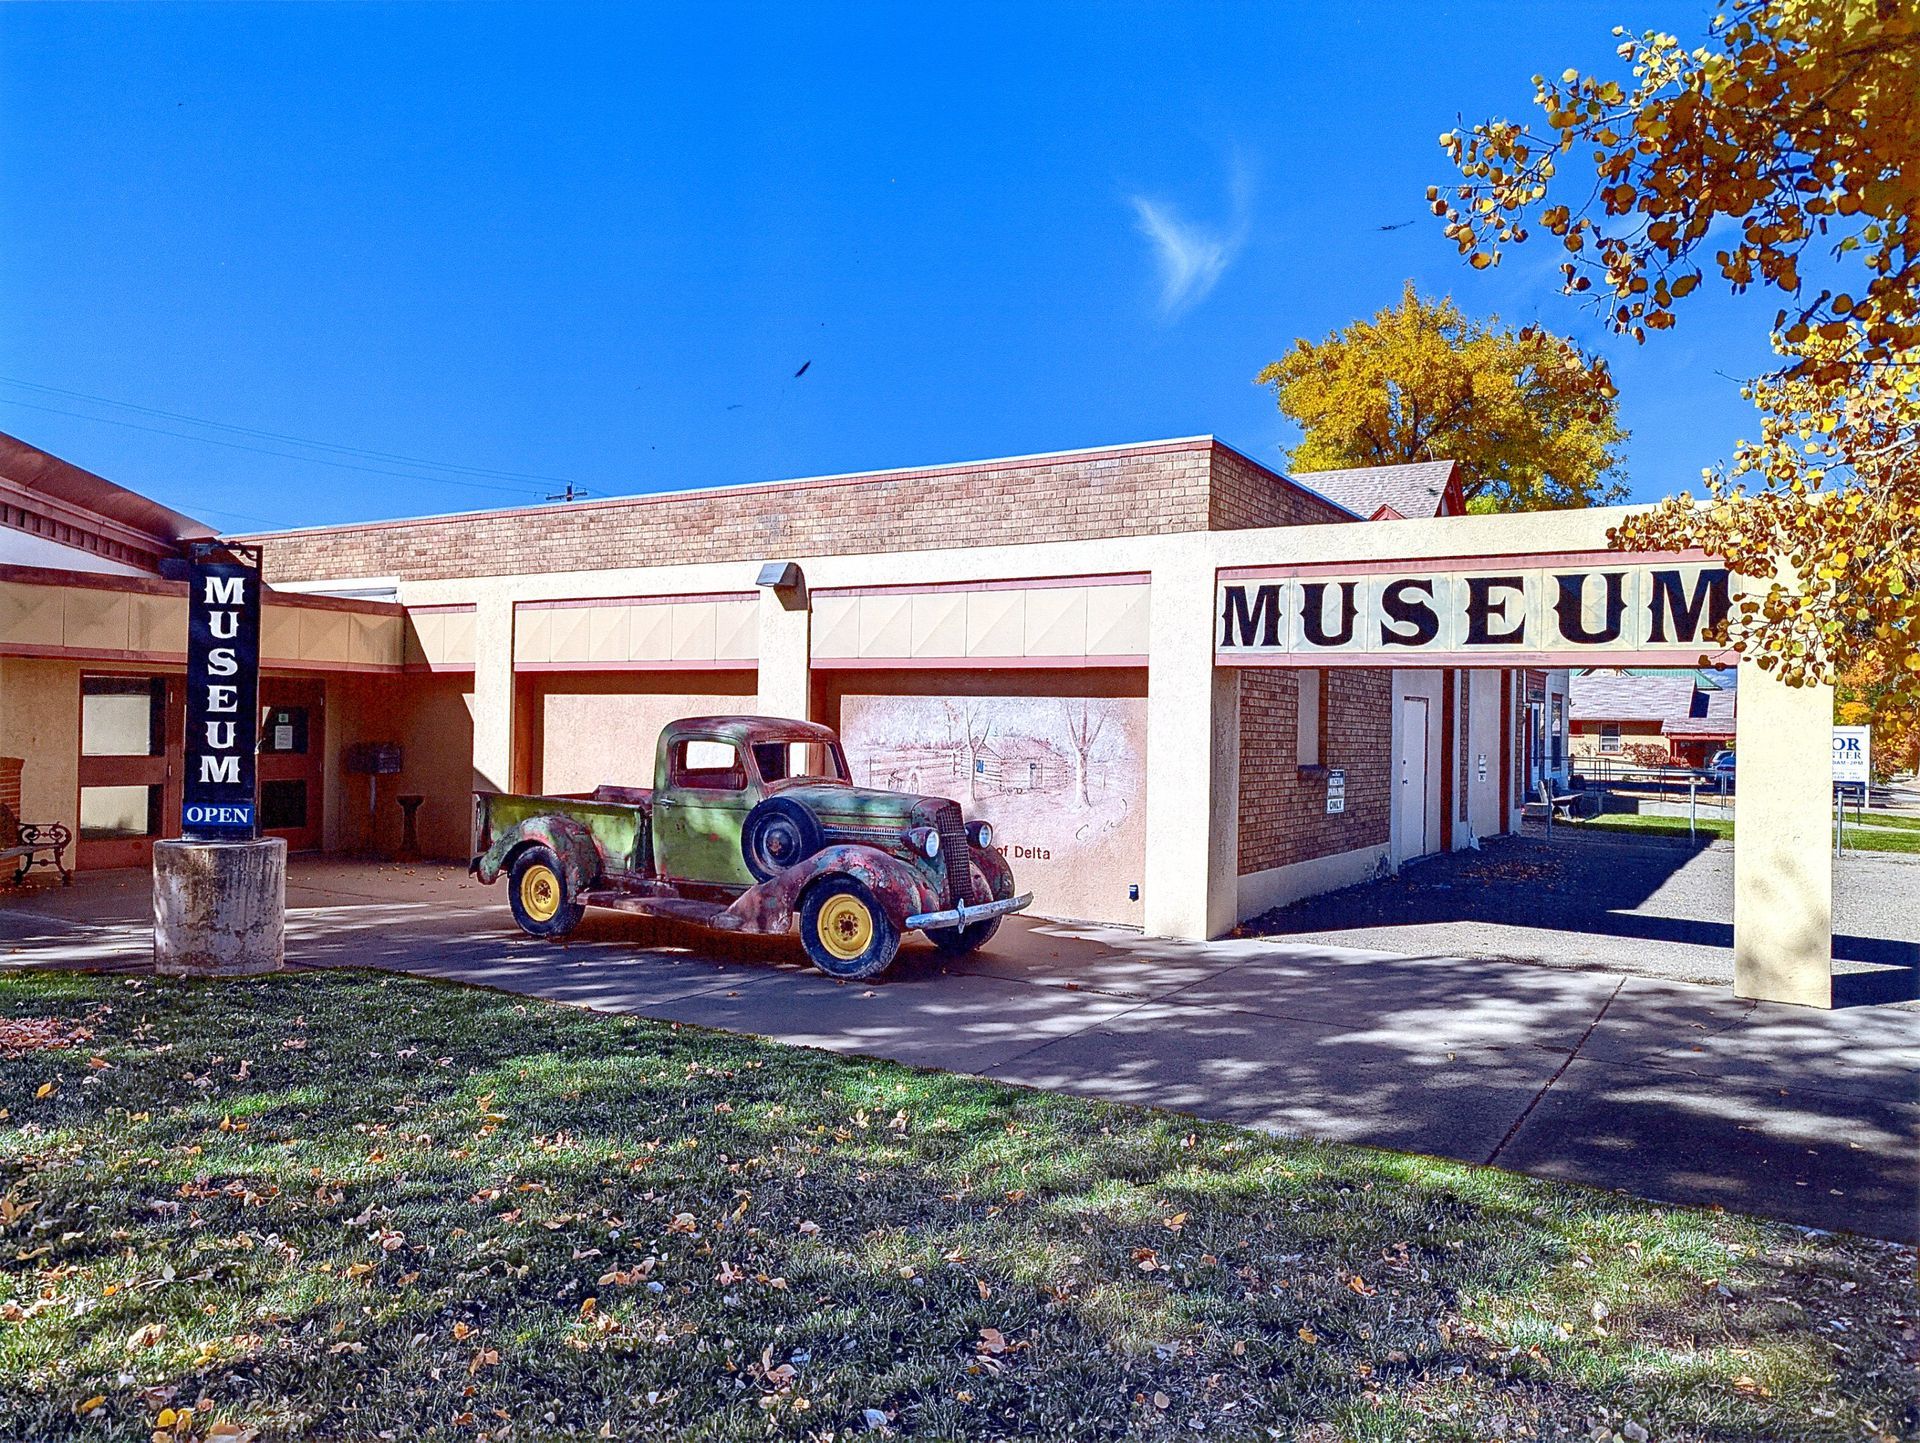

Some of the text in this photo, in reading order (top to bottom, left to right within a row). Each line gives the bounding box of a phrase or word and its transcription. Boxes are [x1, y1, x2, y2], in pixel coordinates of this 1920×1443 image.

[1220, 568, 1734, 647] MUSEUM
[199, 576, 246, 783] MUSEUM
[1329, 800, 1343, 810] ONLY
[186, 806, 250, 823] OPEN
[996, 845, 1050, 860] of Delta
